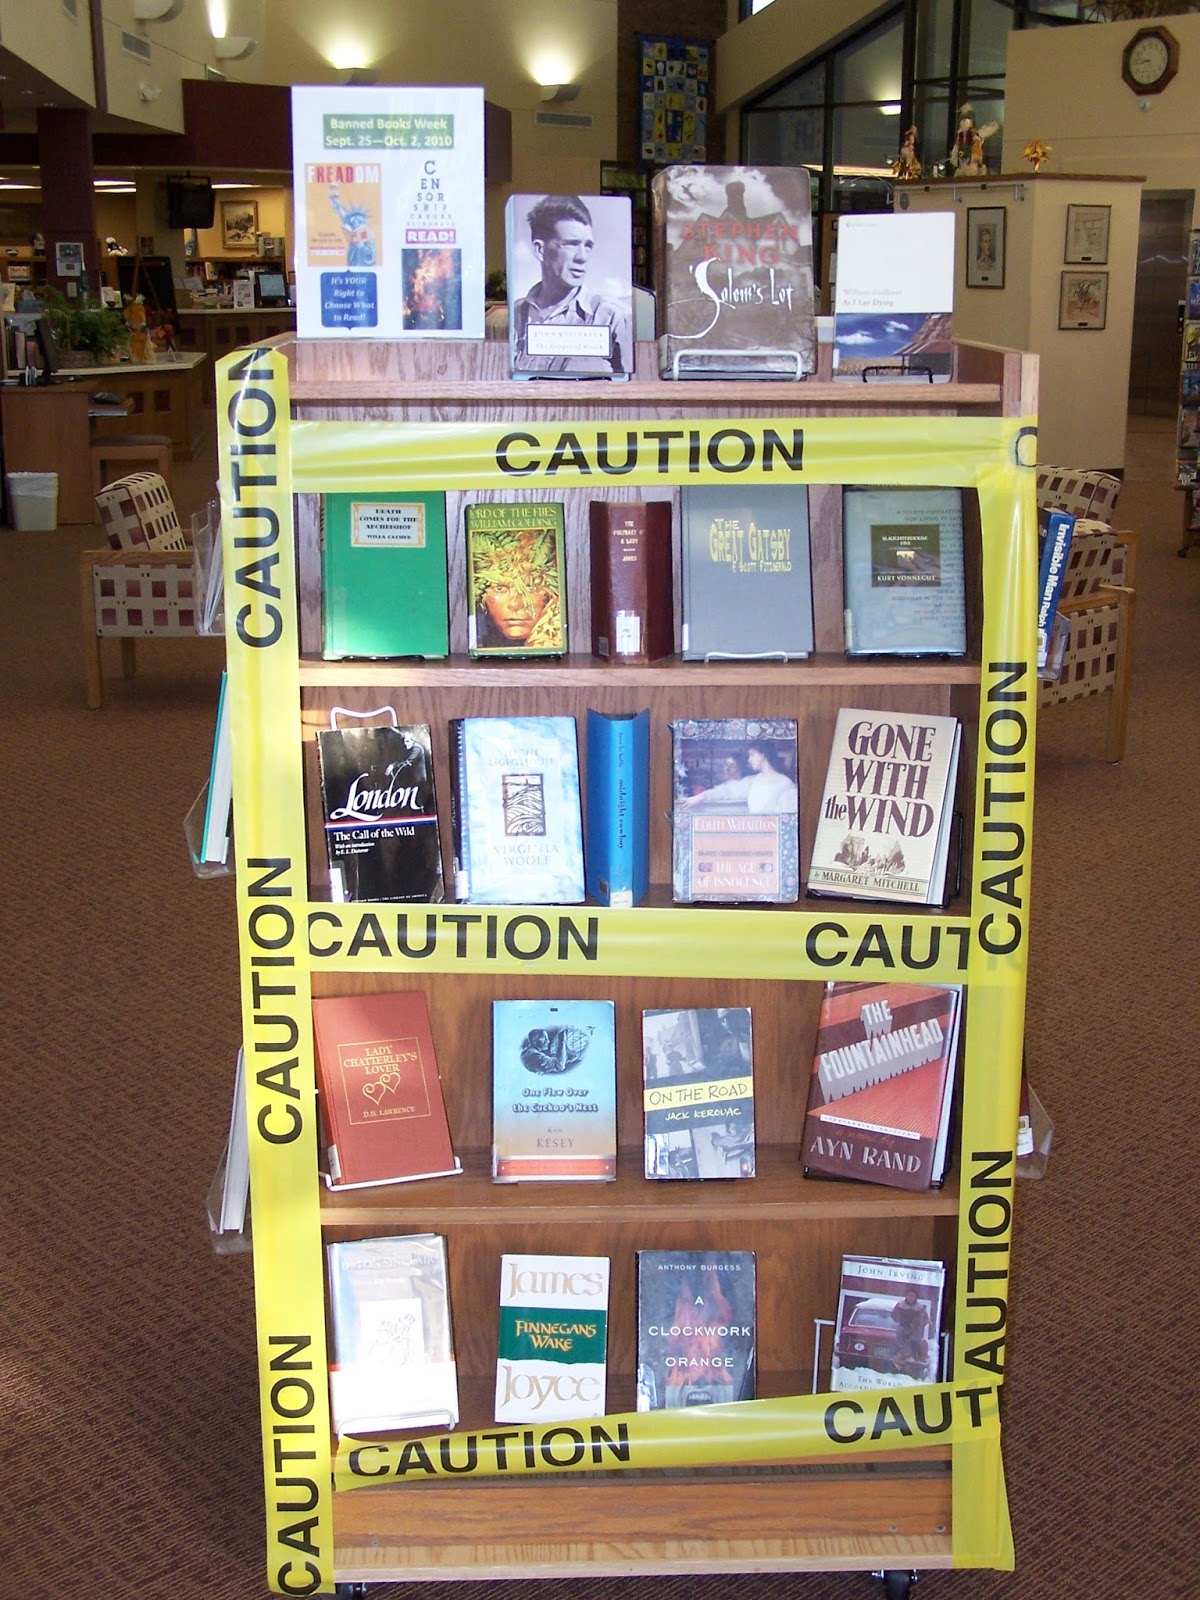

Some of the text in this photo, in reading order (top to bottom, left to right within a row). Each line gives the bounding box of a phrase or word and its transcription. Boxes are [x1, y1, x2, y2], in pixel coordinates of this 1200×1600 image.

[330, 118, 447, 129] Banned Books Week
[325, 136, 355, 149] Sept.
[411, 136, 421, 148] 2,
[425, 135, 452, 147] 2010
[307, 166, 379, 184] FREADOM
[424, 160, 436, 175] C
[406, 230, 454, 243] READ!
[679, 221, 799, 241] STEPHEN
[703, 243, 780, 265] KING
[331, 276, 367, 285] It's YOUR
[333, 289, 355, 298] Right
[769, 267, 794, 314] Lot
[872, 299, 894, 308] Dying
[343, 313, 366, 321] Read!
[495, 427, 804, 478] CAUTION
[228, 348, 284, 649] CAUTION
[492, 507, 507, 518] OF
[508, 507, 532, 518] THE
[532, 506, 557, 517] FLIES
[470, 518, 557, 529] WILLIAM GOLDING
[714, 518, 740, 530] THE
[709, 522, 791, 563] GREAT GATSBY
[739, 561, 757, 573] SCOTT
[1038, 523, 1071, 627] Invisible Man Ralph
[848, 721, 936, 762] GONE
[842, 757, 930, 801] WITH
[329, 772, 425, 822] London
[825, 794, 934, 838] the WIND
[978, 661, 1028, 955] CAUTION
[726, 818, 777, 830] WHARTON
[333, 826, 415, 842] The Call of the Wild
[617, 819, 627, 849] cowboy
[504, 855, 551, 866] WOOLF
[716, 862, 754, 873] THE AGE
[822, 871, 869, 886] MARGARET
[873, 877, 920, 892] MITCHELL
[308, 912, 598, 962] CAUTION
[246, 856, 302, 1147] CAUTION
[861, 999, 894, 1027] THE
[364, 1045, 393, 1057] LADY
[820, 1018, 943, 1083] FOUNTAINHEAD
[343, 1052, 418, 1069] CHATTERLEY'S
[365, 1063, 400, 1075] LOVER
[521, 1088, 589, 1098] One Flew Over
[649, 1082, 748, 1106] ON THE ROAD
[363, 1105, 416, 1118] D.H. LAWRENCE
[512, 1103, 599, 1113] the Cuckoo's Nest
[664, 1107, 742, 1122] JACK KEROUAC
[537, 1138, 575, 1149] KESEY
[810, 1136, 854, 1160] AYN
[862, 1146, 921, 1173] RAND
[857, 1265, 924, 1281] JOHN IRVING
[506, 1263, 604, 1301] James
[694, 1295, 704, 1306] A
[515, 1320, 597, 1338] FINNEGANS
[648, 1326, 751, 1337] CLOCKWORK
[529, 1334, 574, 1352] WAKE
[665, 1357, 734, 1368] ORANGE
[857, 1375, 872, 1384] THE
[500, 1365, 602, 1411] Joyce
[348, 1422, 632, 1478] CAUTION
[268, 1333, 329, 1597] CAUTION
